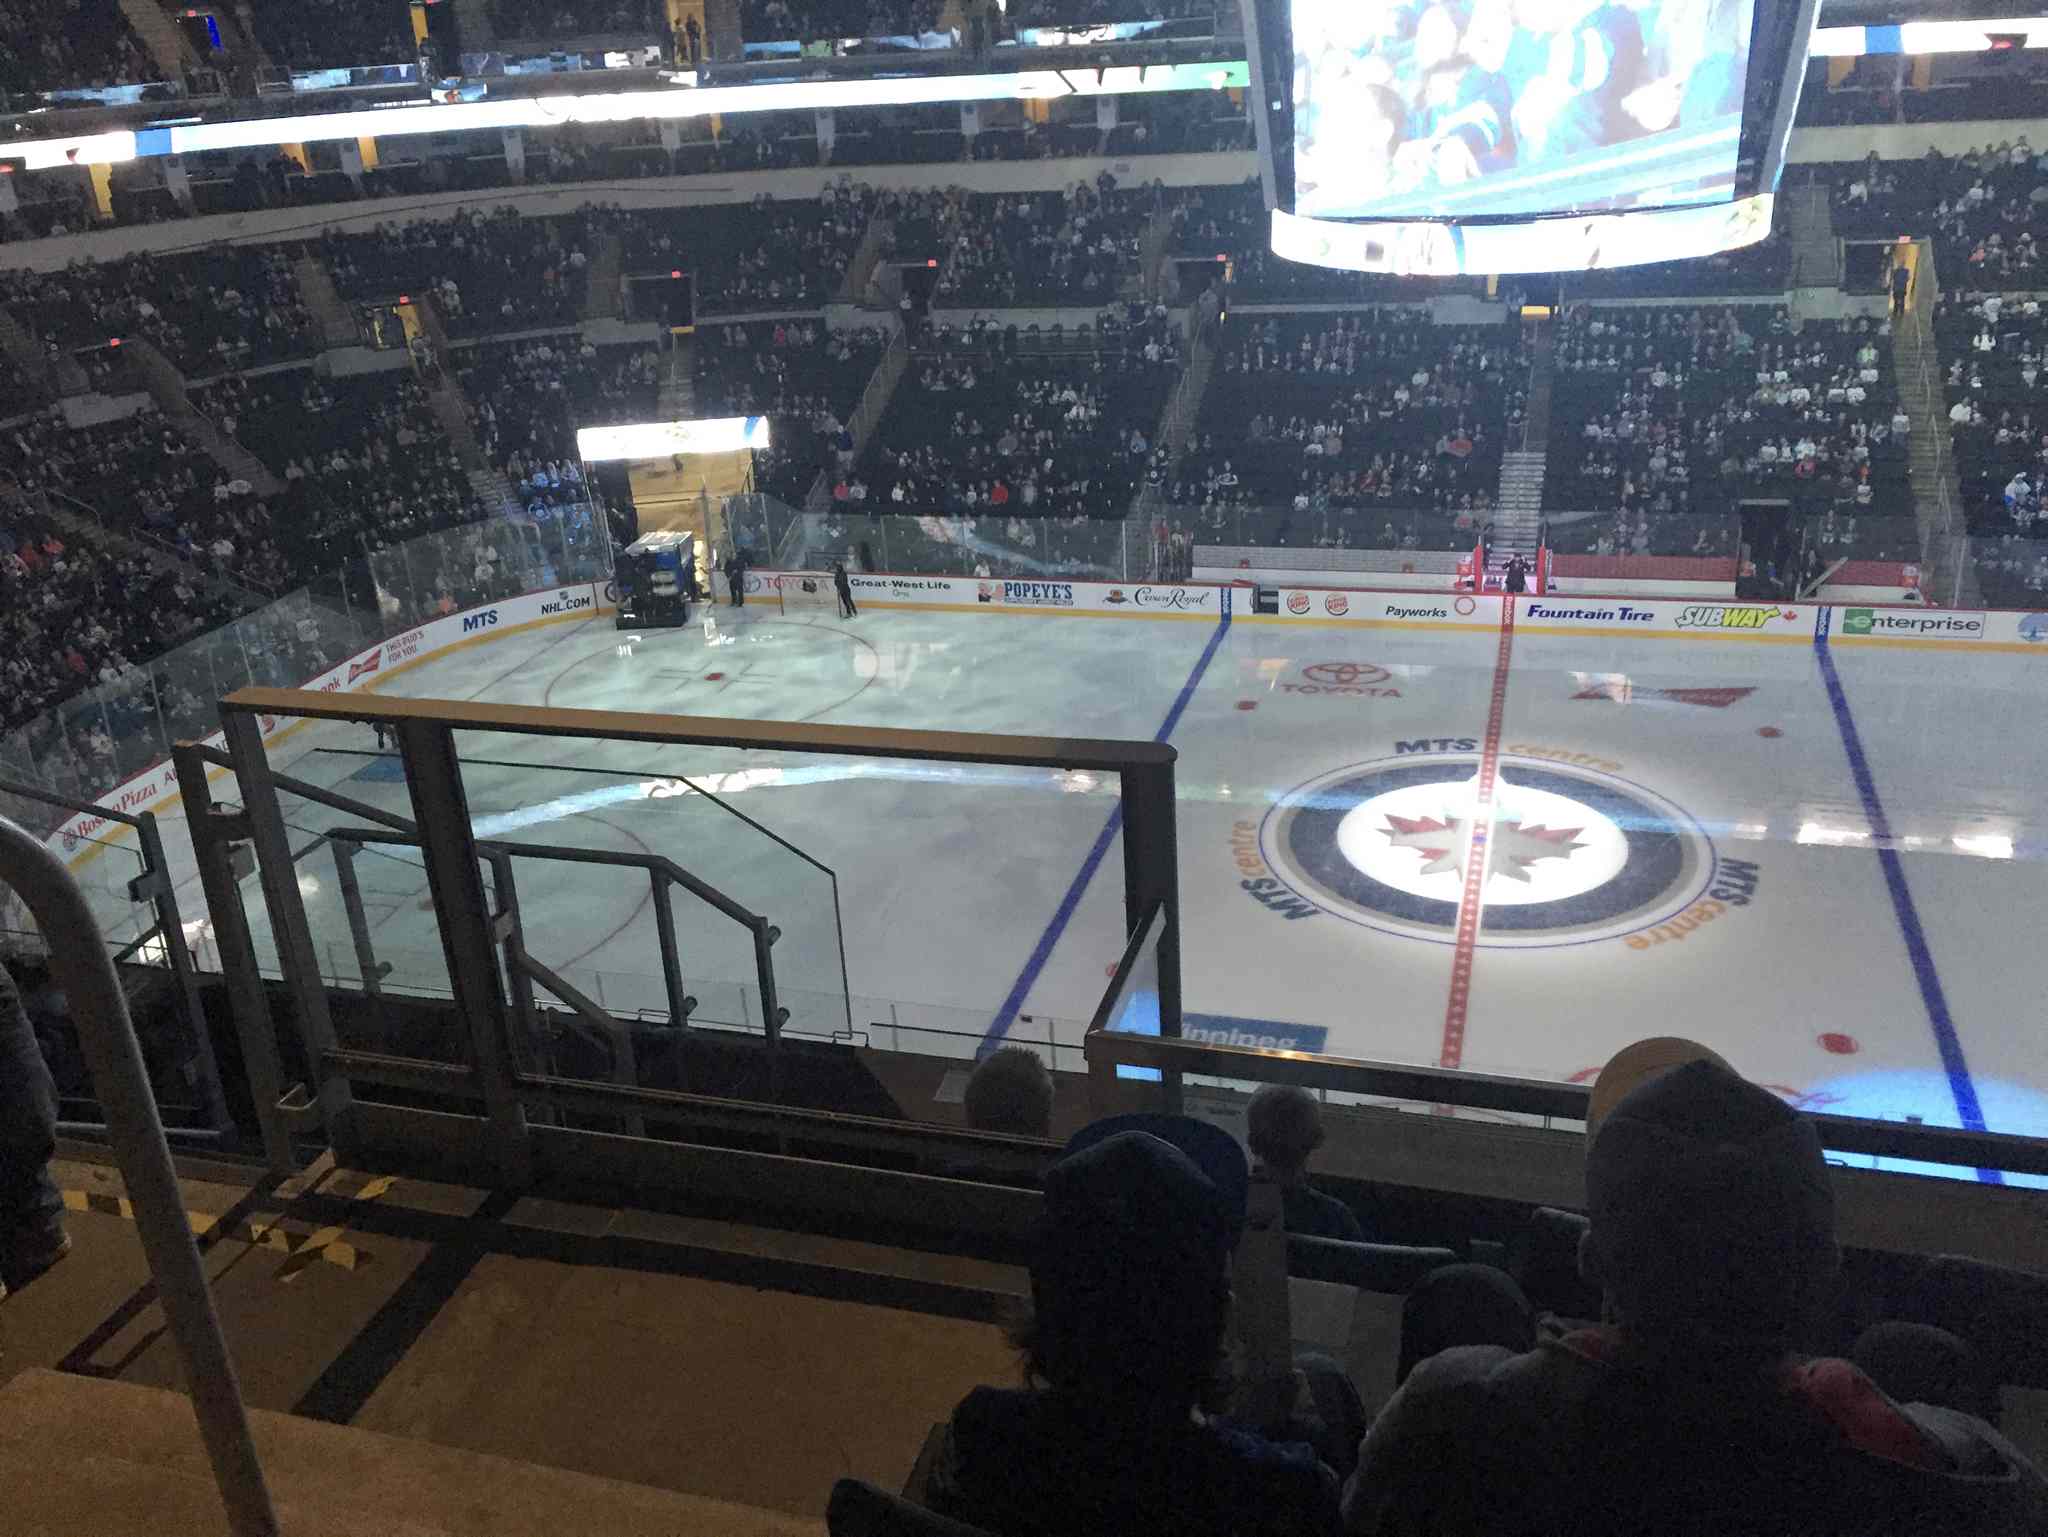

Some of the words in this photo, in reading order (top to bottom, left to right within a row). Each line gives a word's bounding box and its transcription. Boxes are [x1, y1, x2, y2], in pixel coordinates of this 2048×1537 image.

[927, 581, 951, 590] Life
[1005, 582, 1073, 600] POPEYE'S
[541, 597, 590, 615] NHL.COM
[1386, 606, 1447, 619] Payworks
[1527, 605, 1613, 622] Fountain
[1618, 608, 1655, 622] Tire
[463, 609, 498, 632] MTS
[1675, 606, 1781, 628] SUBWAY
[1853, 615, 1981, 633] enterprise
[1282, 684, 1402, 699] TOYOTA
[1395, 738, 1478, 754] MTS
[120, 783, 159, 811] Pizza
[1709, 857, 1760, 906] MTS
[1241, 878, 1321, 920] MTS
